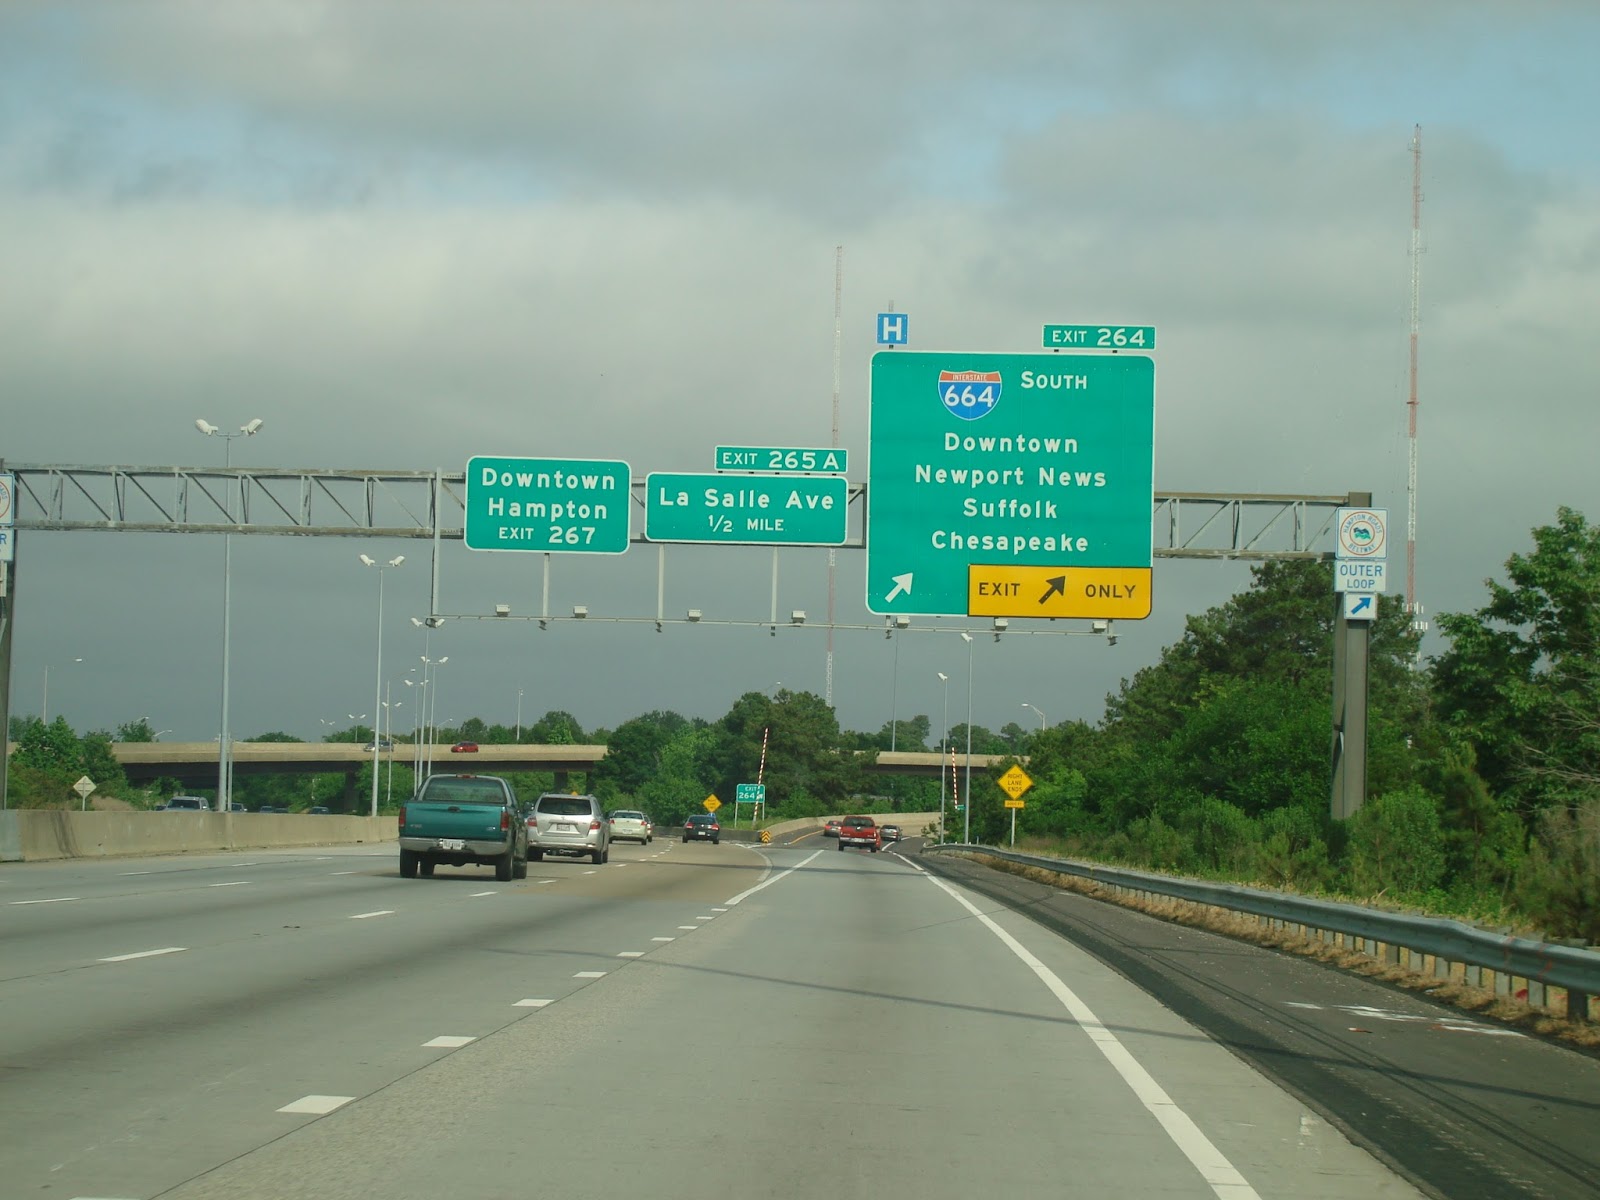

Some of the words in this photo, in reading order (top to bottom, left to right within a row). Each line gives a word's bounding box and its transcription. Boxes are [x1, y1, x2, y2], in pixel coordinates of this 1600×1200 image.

[883, 317, 902, 341] H
[1052, 330, 1087, 343] EXIT
[1097, 328, 1146, 347] 264
[952, 373, 987, 381] INTERSTATE
[1020, 371, 1088, 389] SOUTH
[944, 385, 994, 408] 664
[944, 432, 1079, 453] Downtown
[722, 452, 757, 465] EXIT
[769, 450, 816, 469] 265
[823, 452, 840, 470] A
[482, 468, 616, 490] Downtown
[915, 464, 1024, 488] Newport
[1039, 467, 1107, 487] News
[660, 488, 689, 507] La
[705, 489, 770, 509] Salle
[786, 490, 834, 510] Ave
[963, 498, 1058, 519] Suffolk
[488, 497, 608, 522] Hampton
[708, 515, 733, 533] 1/2
[747, 518, 784, 532] MILE
[1344, 514, 1365, 533] HAMPTON
[499, 526, 534, 540] EXIT
[549, 526, 596, 545] 267
[931, 531, 1089, 555] Chesapeake
[1340, 565, 1382, 576] OUTER
[978, 582, 1020, 596] EXIT
[1085, 584, 1136, 599] ONLY
[1346, 579, 1376, 589] LOOP
